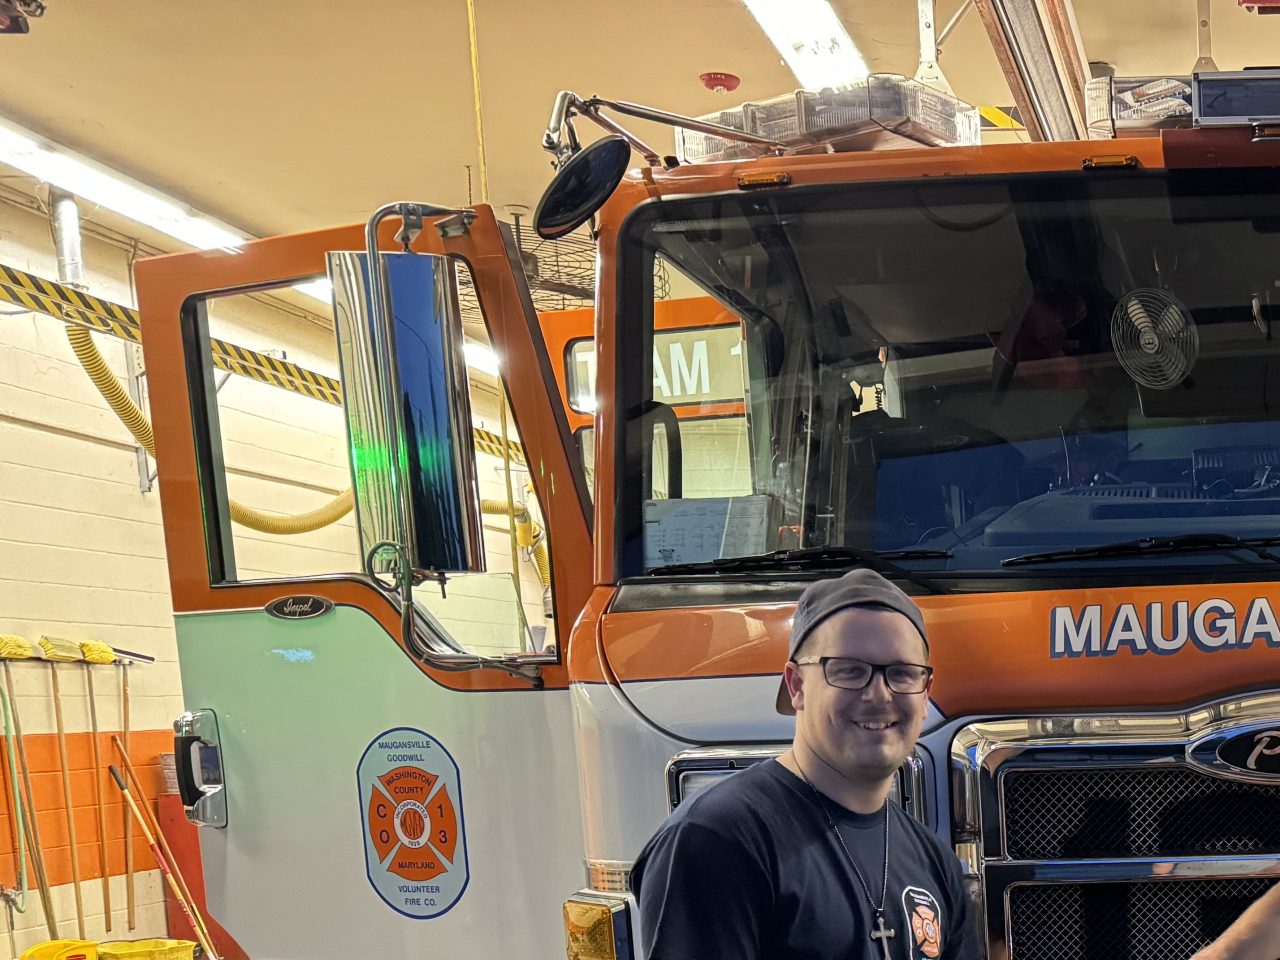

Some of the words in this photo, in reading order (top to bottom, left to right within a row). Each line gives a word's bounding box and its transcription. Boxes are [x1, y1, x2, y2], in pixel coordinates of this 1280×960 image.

[378, 740, 432, 750] MAUGANSVILLE
[386, 753, 426, 763] GOODWILL
[385, 771, 433, 787] WASHINGTON
[393, 786, 425, 795] COUNTY
[397, 861, 436, 870] MARYLAND
[397, 885, 441, 894] VOLUNTEER
[404, 897, 422, 907] FIRE
[424, 897, 438, 907] CO.
